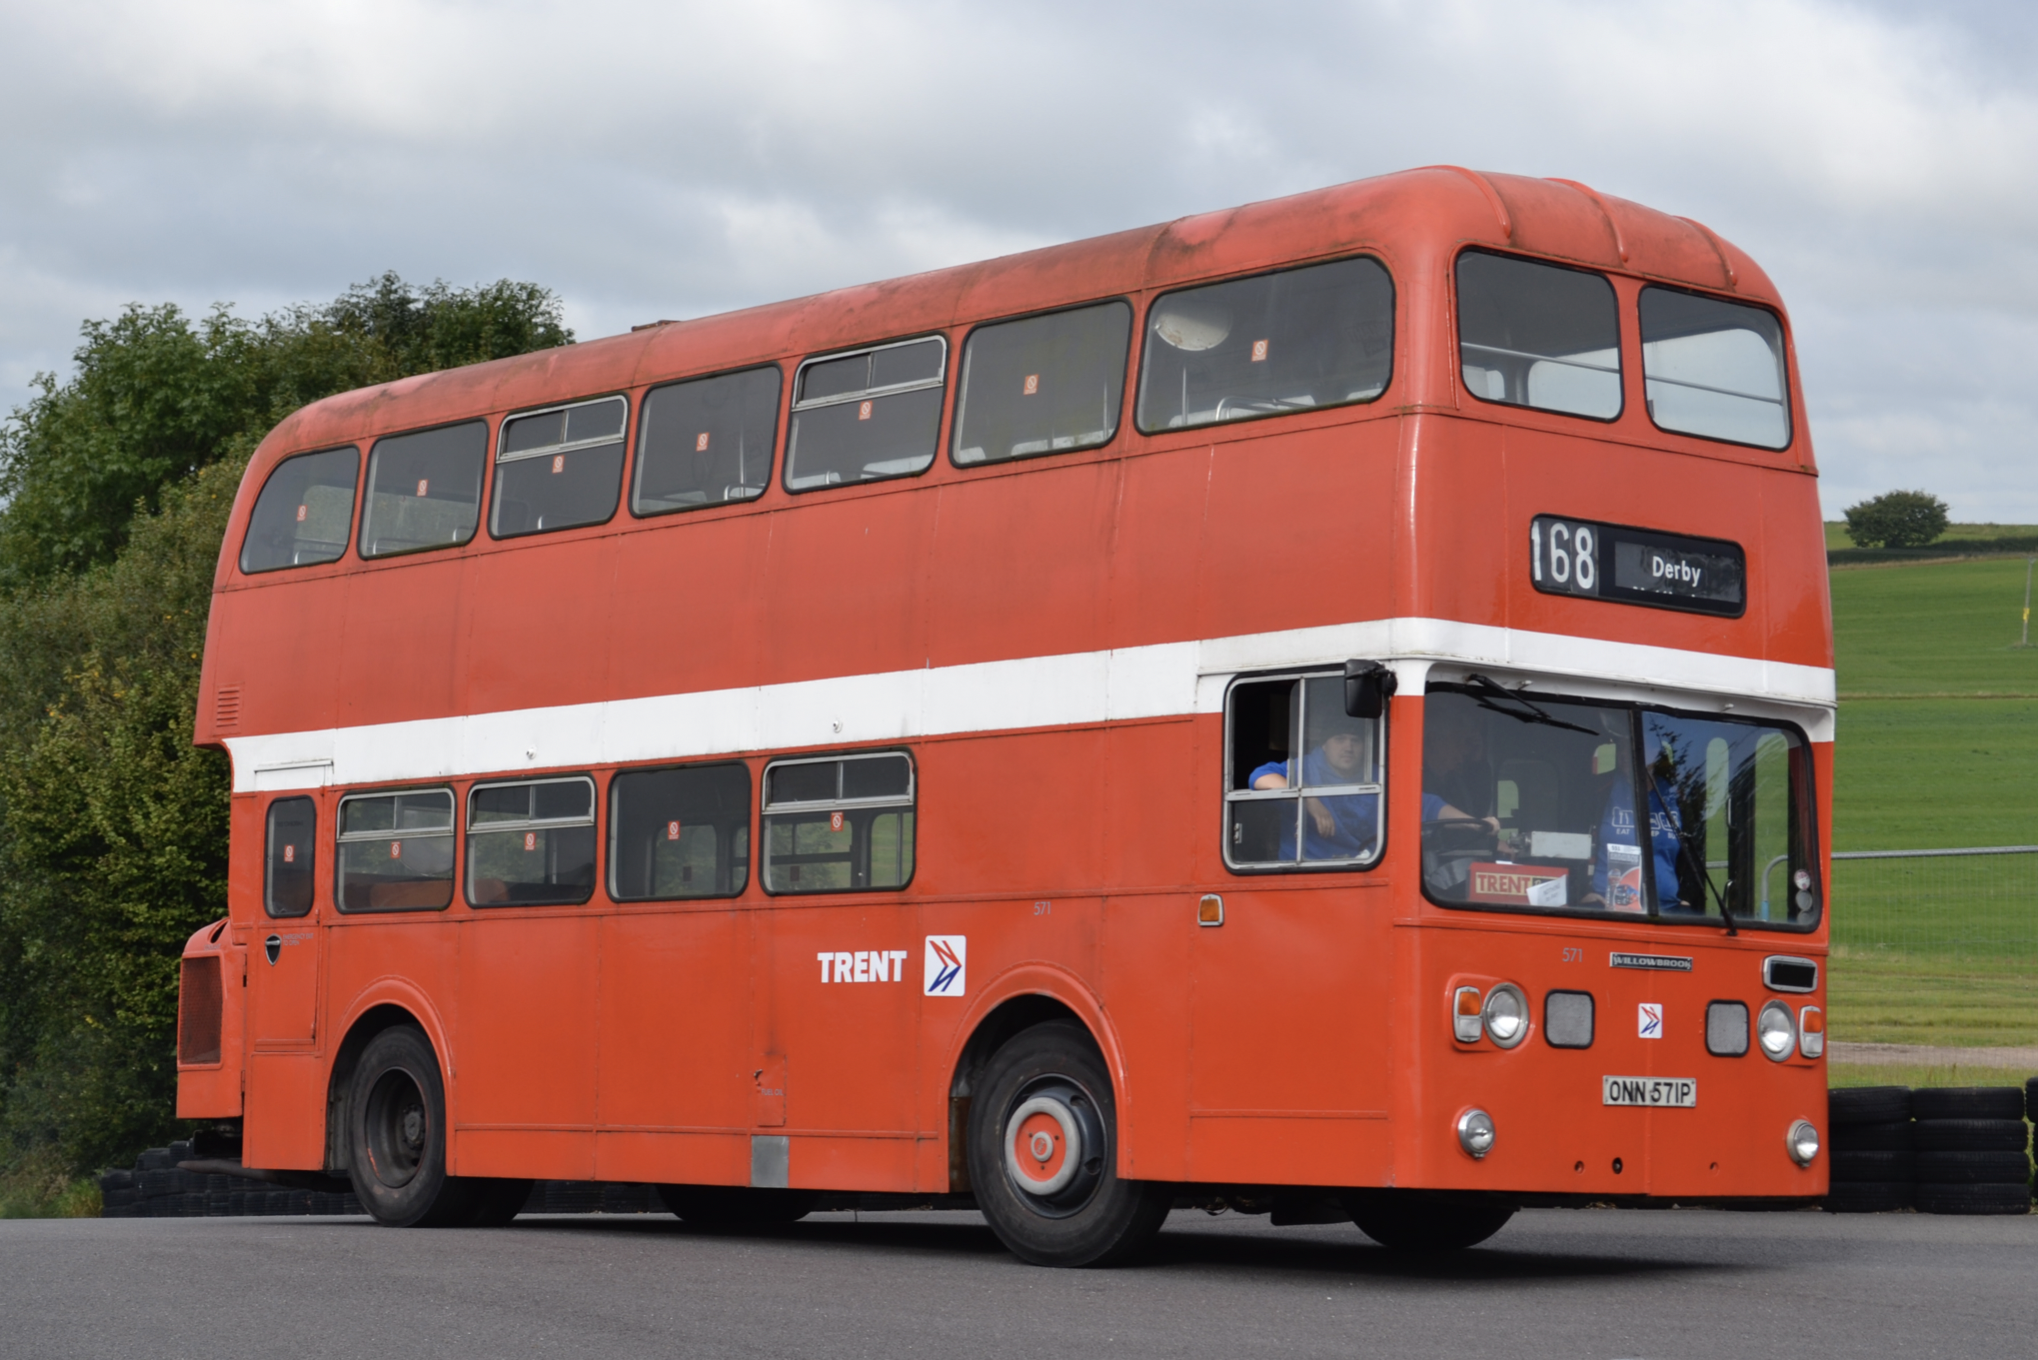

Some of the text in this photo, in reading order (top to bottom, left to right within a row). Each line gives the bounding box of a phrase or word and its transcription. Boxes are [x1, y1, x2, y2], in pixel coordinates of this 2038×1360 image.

[1531, 521, 1595, 589] 168
[1652, 556, 1701, 587] Derby
[1477, 874, 1531, 893] TRENT
[1034, 901, 1052, 916] 571
[1562, 947, 1583, 962] 571
[1613, 953, 1691, 970] WILLOWBROOK
[817, 950, 907, 984] TRENT
[761, 1088, 784, 1096] FUEL OIL
[1609, 1080, 1691, 1104] ONN 571P
